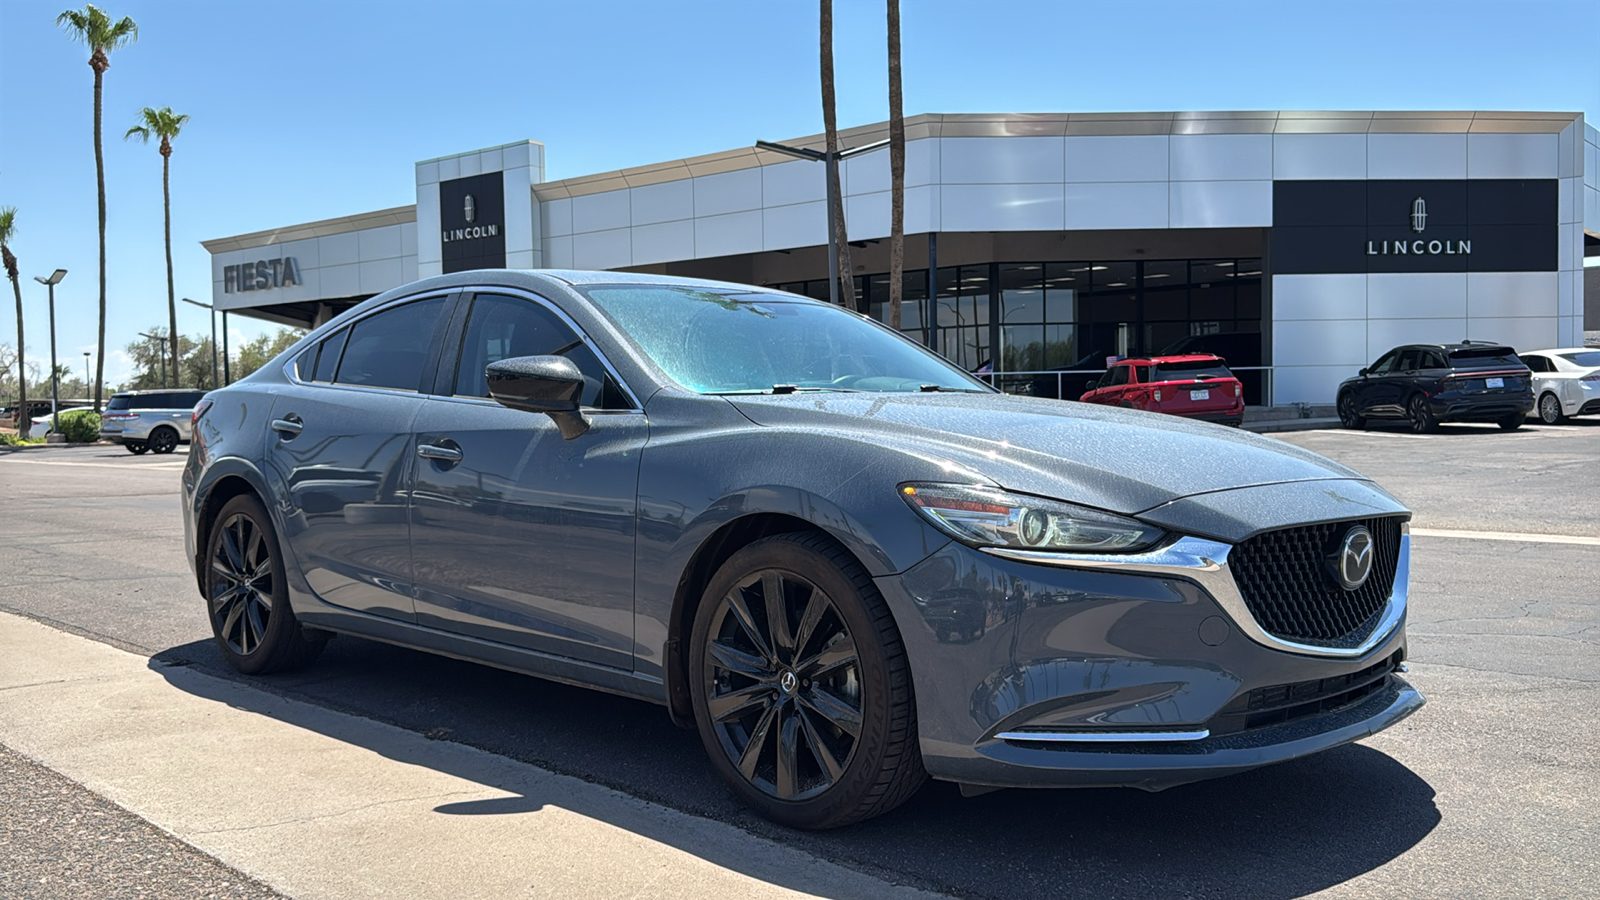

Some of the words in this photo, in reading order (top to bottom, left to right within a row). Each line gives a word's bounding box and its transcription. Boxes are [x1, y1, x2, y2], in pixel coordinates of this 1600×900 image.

[443, 224, 498, 242] LINCOLN
[1367, 240, 1472, 255] LINCOLN
[224, 256, 302, 294] FIESTA
